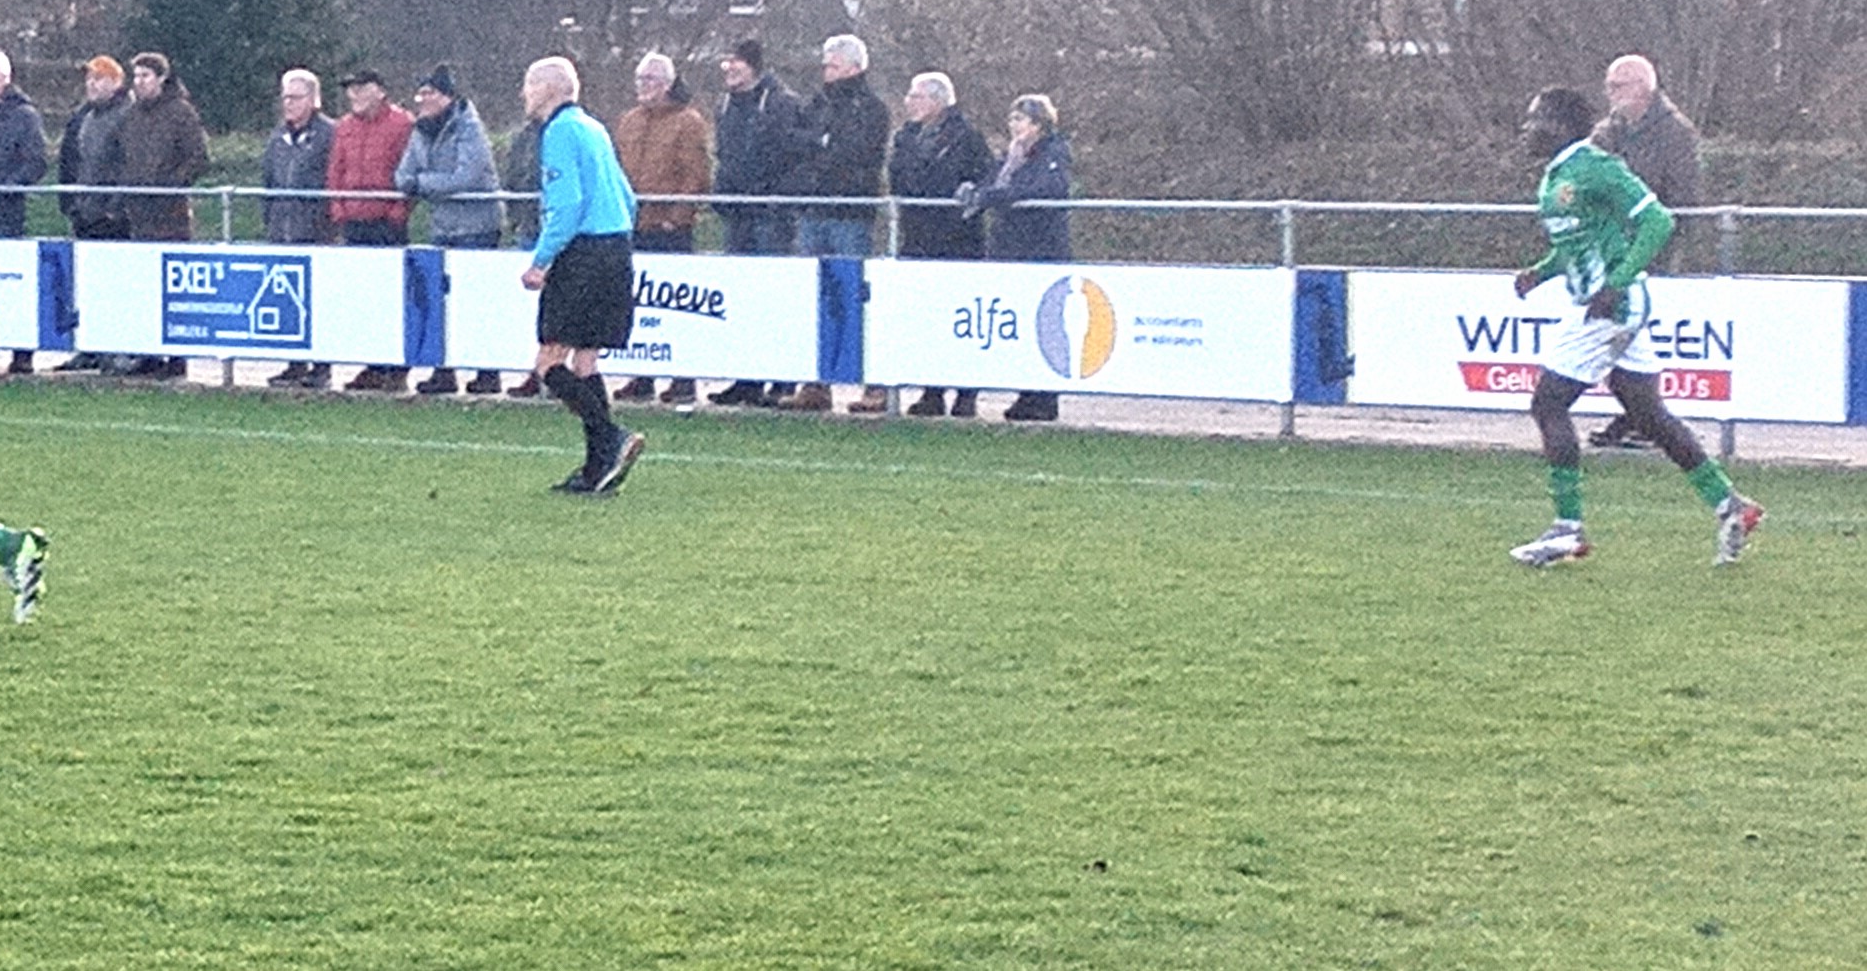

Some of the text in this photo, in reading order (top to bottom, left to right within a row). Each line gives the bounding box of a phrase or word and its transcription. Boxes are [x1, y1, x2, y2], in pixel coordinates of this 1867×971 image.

[632, 269, 727, 321] hoeve
[953, 297, 1020, 351] alfa
[1659, 371, 1711, 398] DJ's
